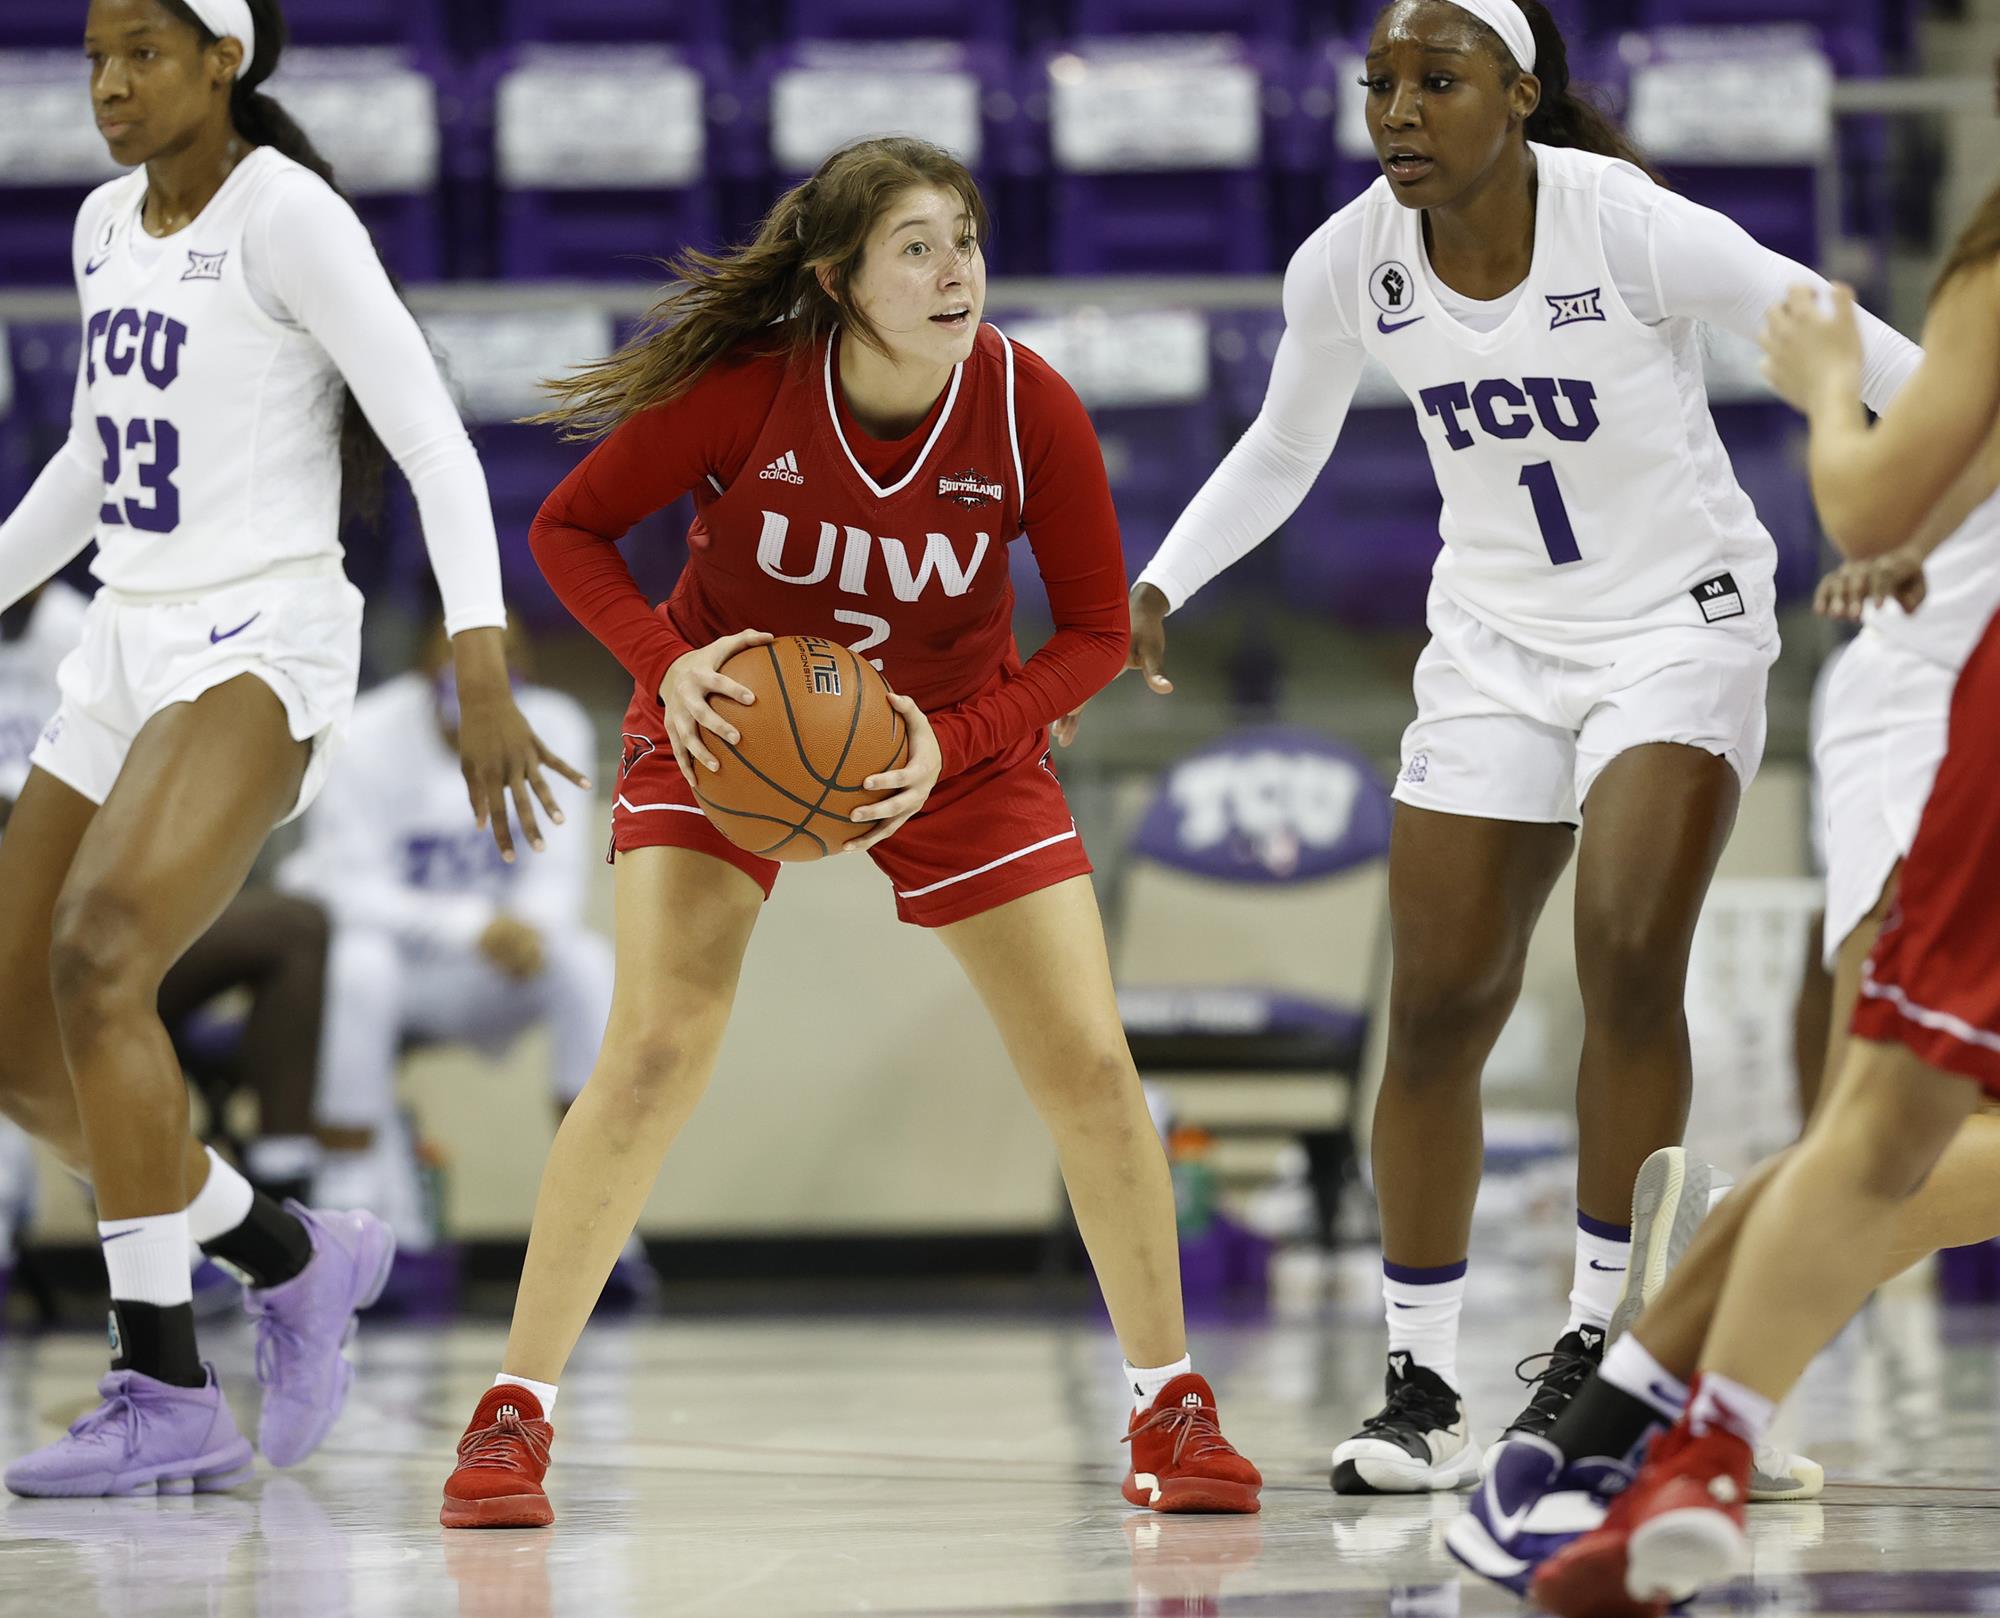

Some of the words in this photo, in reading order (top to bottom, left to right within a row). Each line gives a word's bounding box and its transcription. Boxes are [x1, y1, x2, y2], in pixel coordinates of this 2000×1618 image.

[1550, 291, 1600, 325] XII
[1418, 376, 1600, 451] TCU
[759, 467, 805, 486] adidas
[938, 478, 1003, 501] SOUTHLAND
[1517, 459, 1583, 566] 1
[756, 510, 990, 602] UIW
[1703, 580, 1725, 597] M
[833, 608, 892, 672] 2
[1169, 750, 1362, 850] TCU
